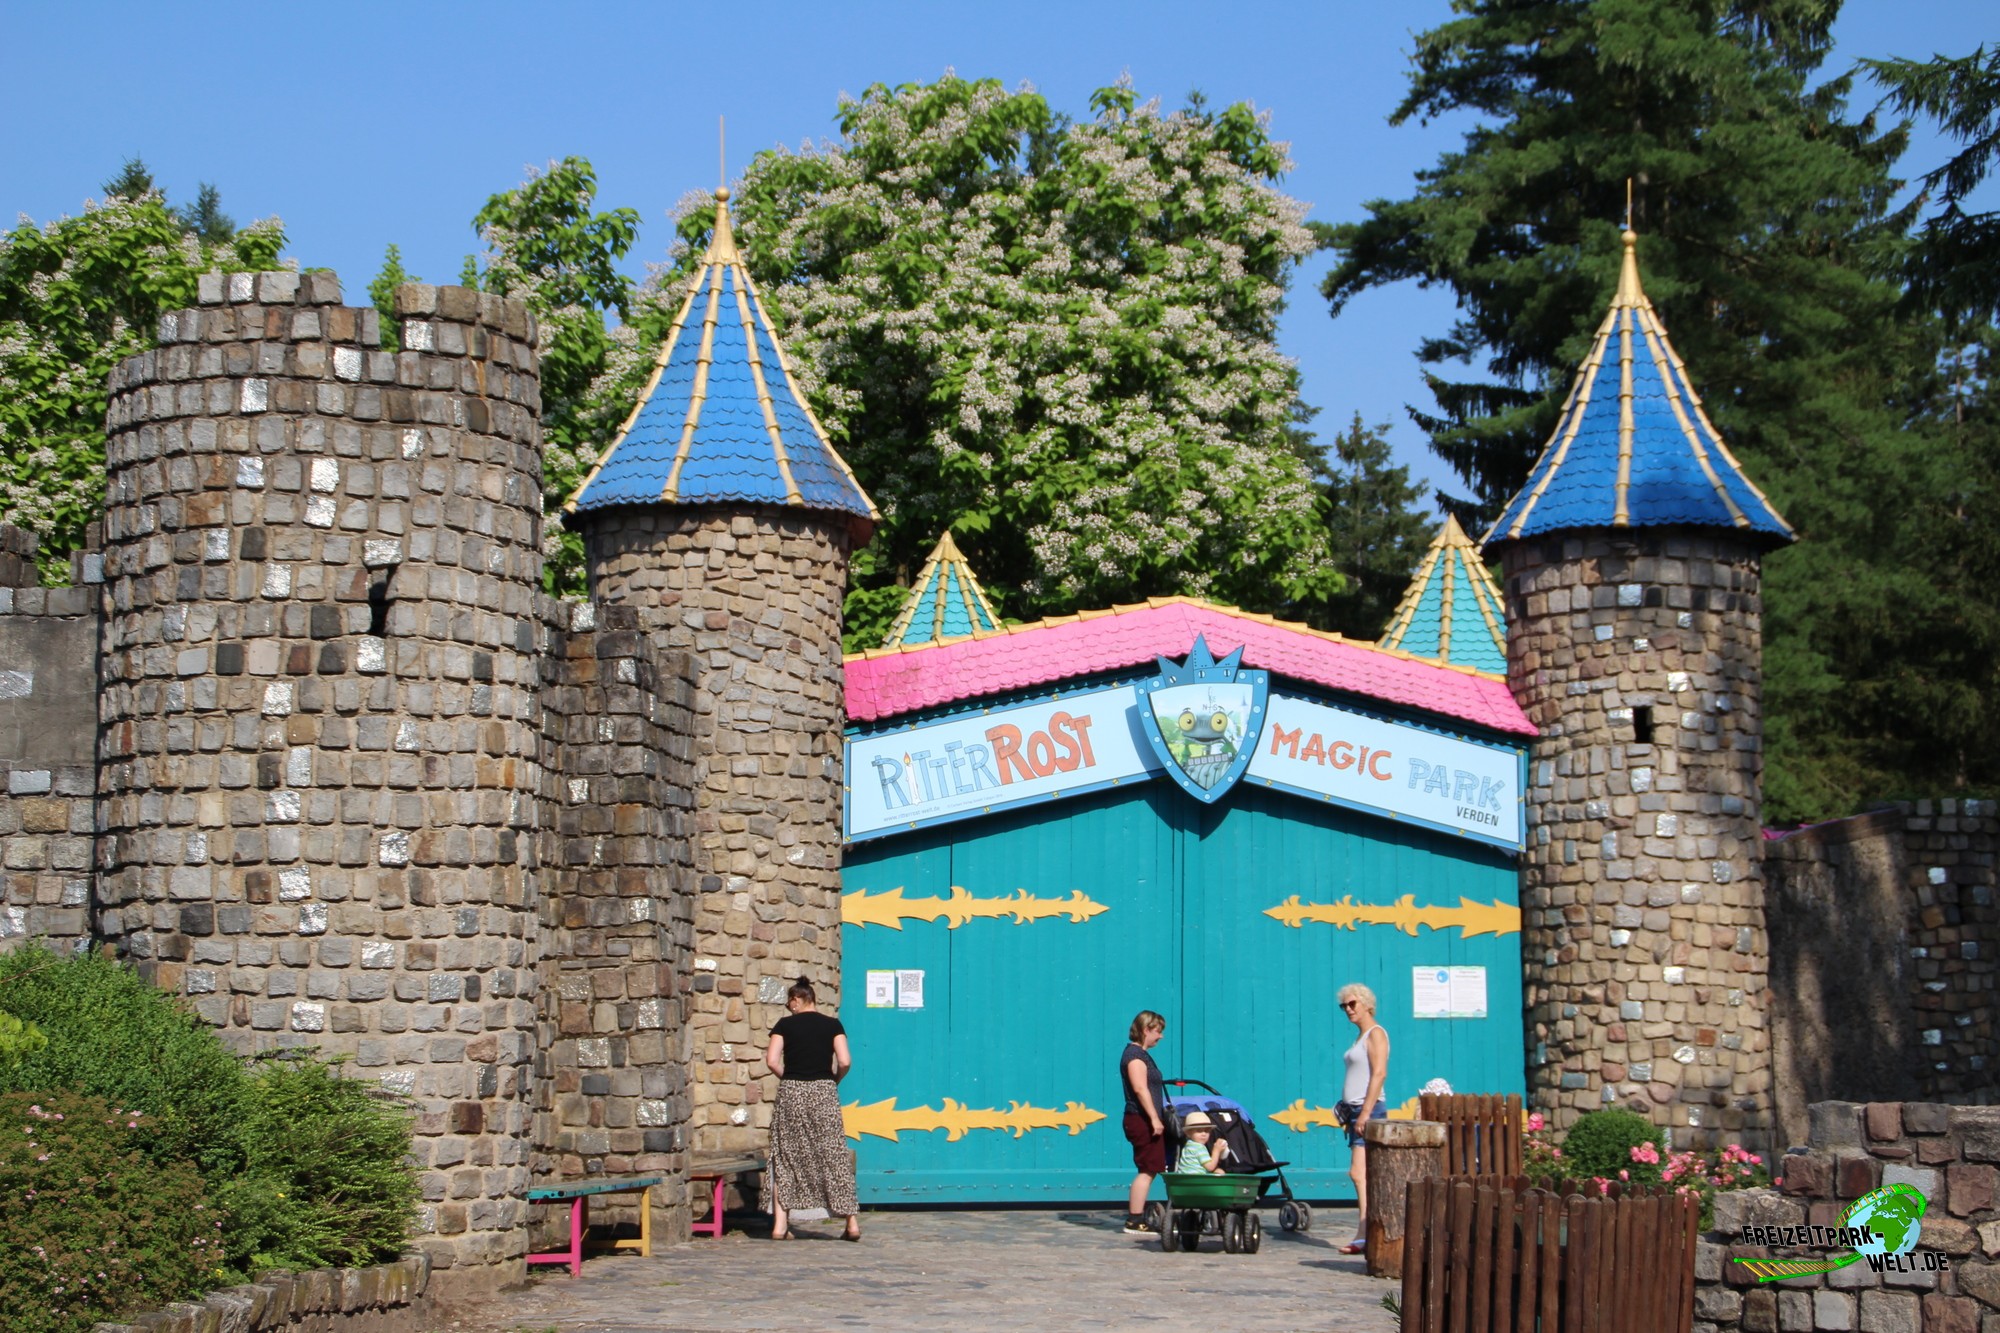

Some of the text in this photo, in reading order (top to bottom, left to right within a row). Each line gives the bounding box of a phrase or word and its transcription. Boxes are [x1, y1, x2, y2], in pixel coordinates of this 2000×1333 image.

[871, 740, 1001, 810] RITTER
[1269, 722, 1506, 812] MAGIC PARK
[1456, 805, 1500, 827] VERDEN
